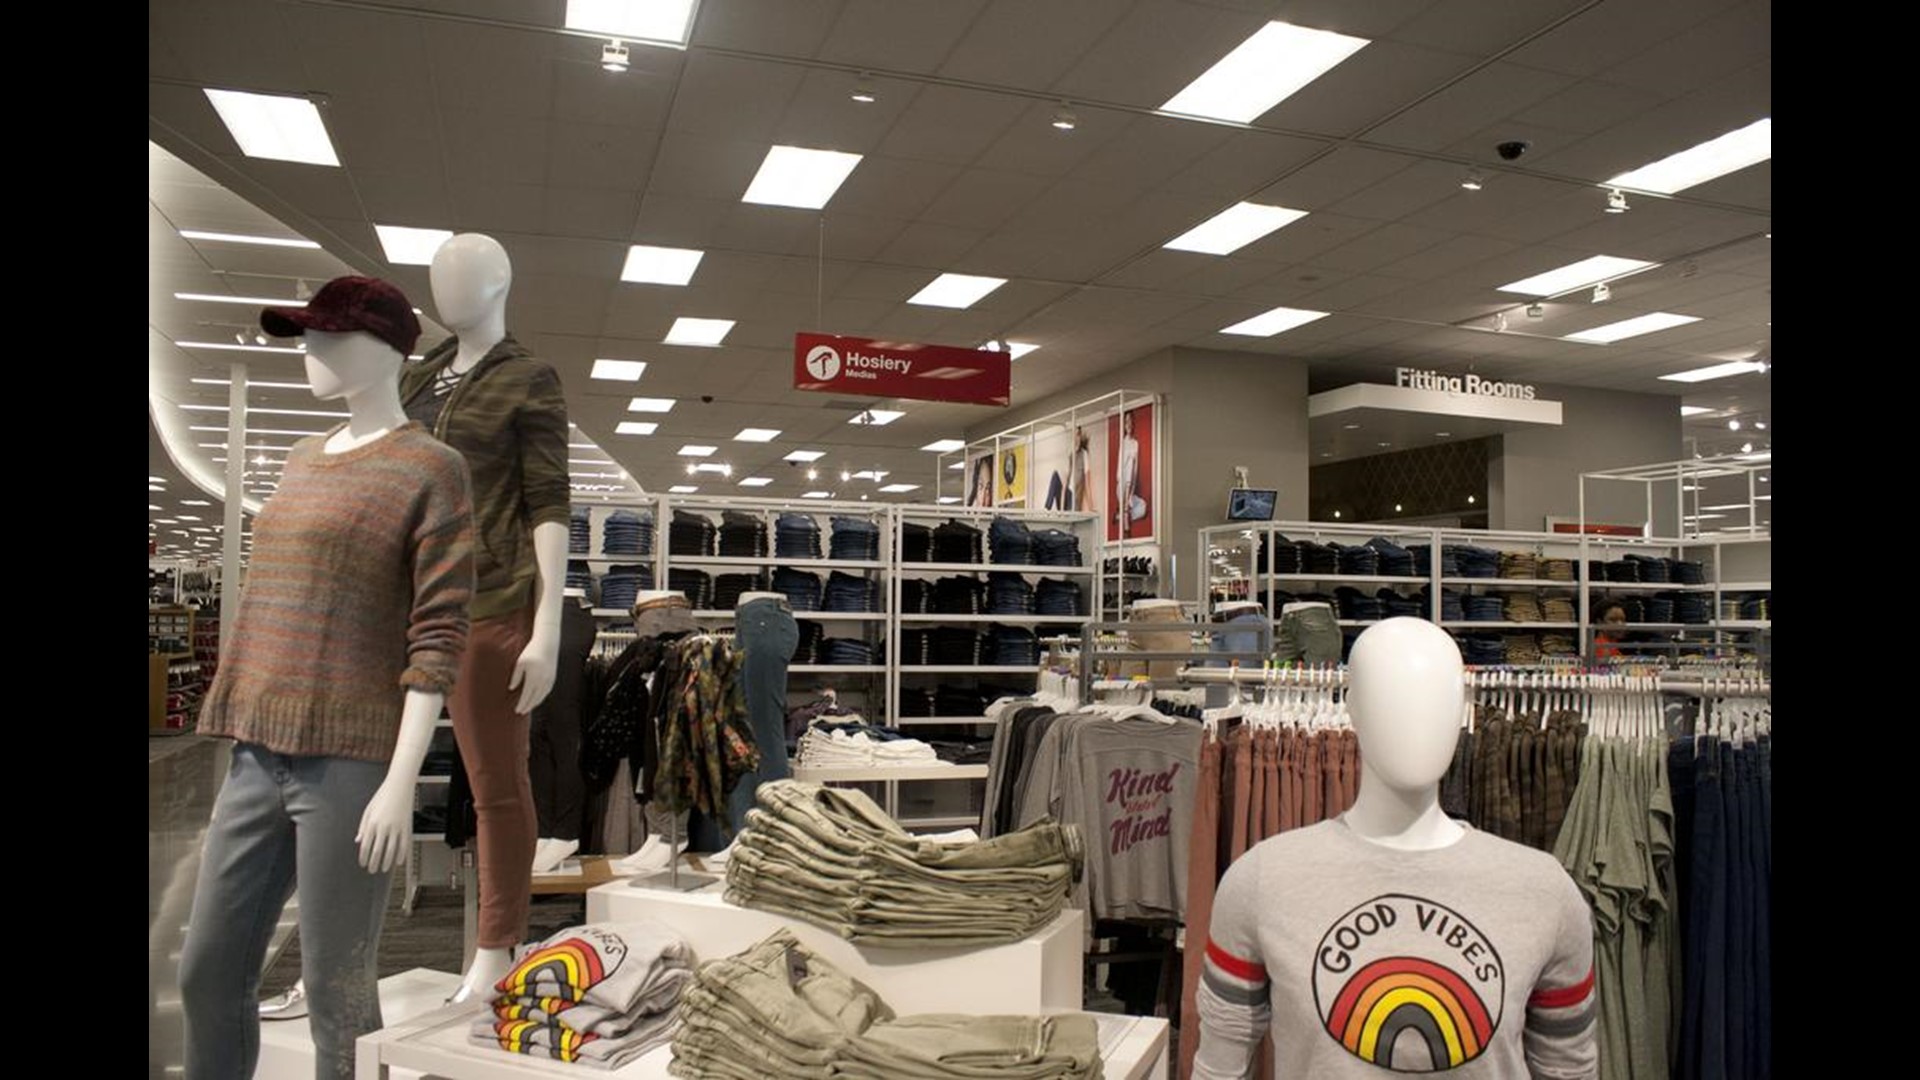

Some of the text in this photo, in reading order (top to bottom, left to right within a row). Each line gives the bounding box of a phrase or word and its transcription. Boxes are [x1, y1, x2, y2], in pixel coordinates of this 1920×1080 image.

[845, 369, 877, 380] Medias
[846, 352, 912, 374] Hosiery
[1396, 367, 1536, 400] Fitting Rooms
[1106, 762, 1180, 808] Kind
[1110, 807, 1172, 856] Mind
[1320, 903, 1499, 983] GOOD VIBES
